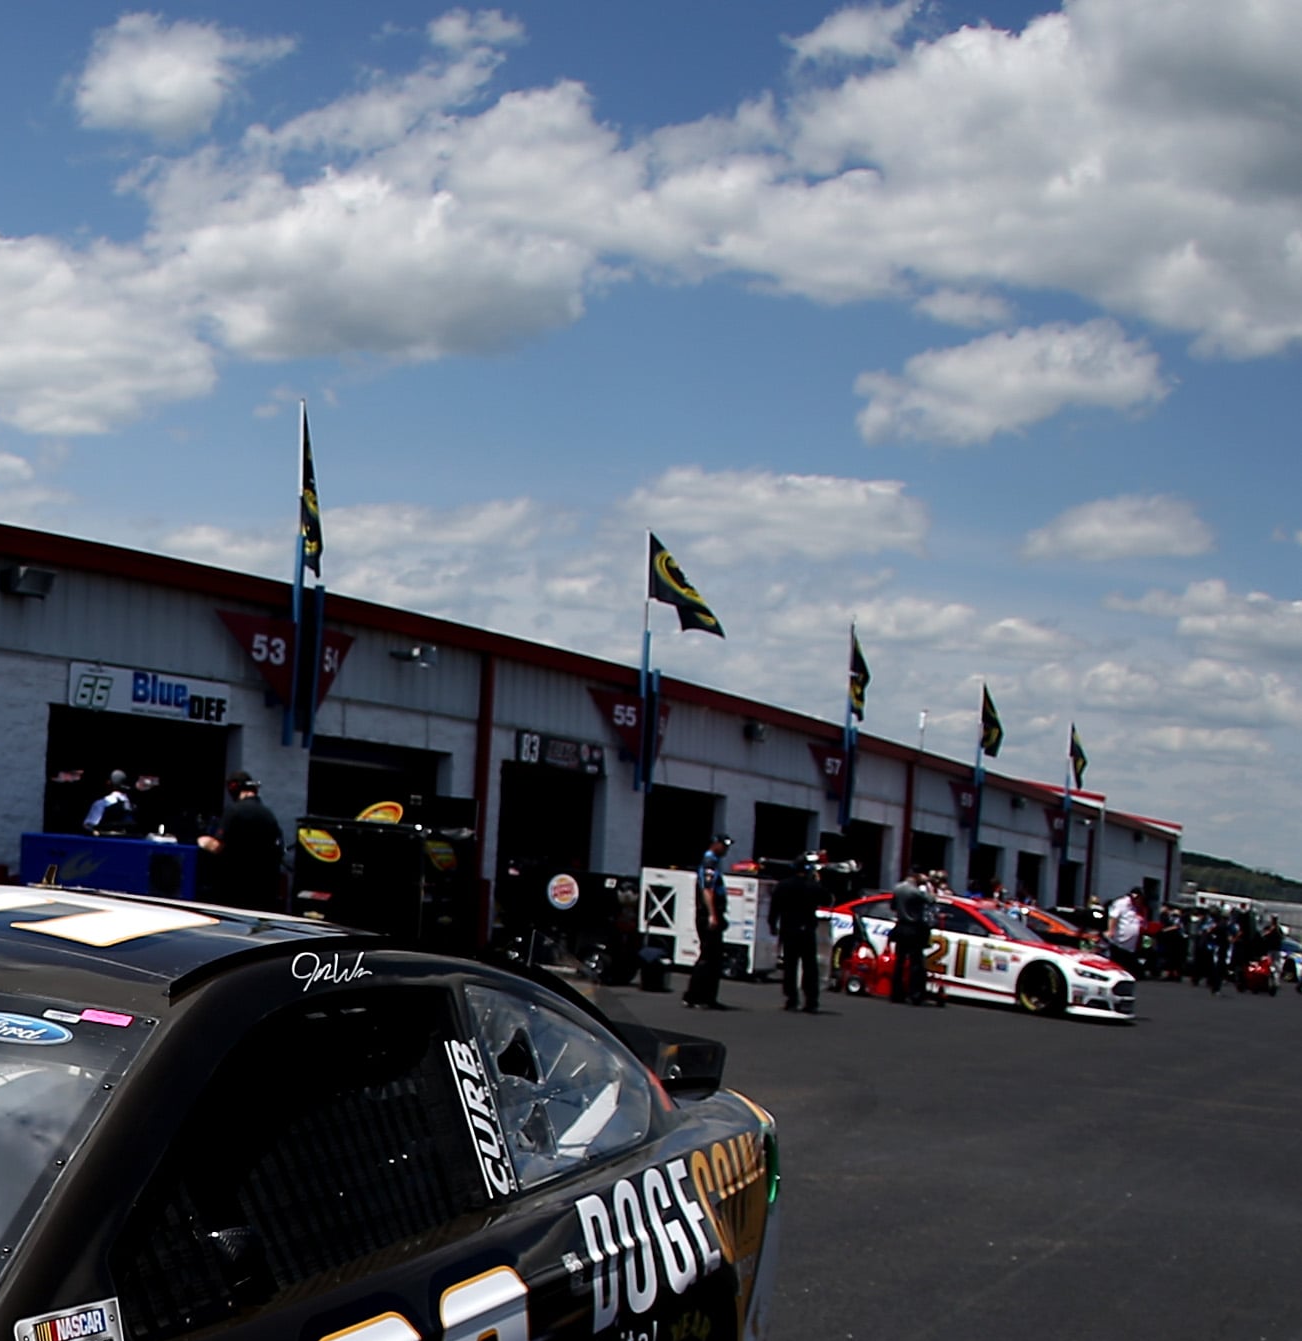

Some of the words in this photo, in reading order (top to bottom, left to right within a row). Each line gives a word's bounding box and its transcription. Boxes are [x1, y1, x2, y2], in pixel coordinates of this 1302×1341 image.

[251, 633, 286, 665] 53
[74, 673, 114, 709] 66
[131, 671, 189, 709] Blue
[189, 694, 227, 723] DEF
[613, 704, 637, 727] 55
[521, 732, 541, 763] 83
[824, 756, 842, 776] 57
[923, 934, 968, 979] 21
[449, 1039, 512, 1198] CURB
[55, 1308, 106, 1341] NASCAR
